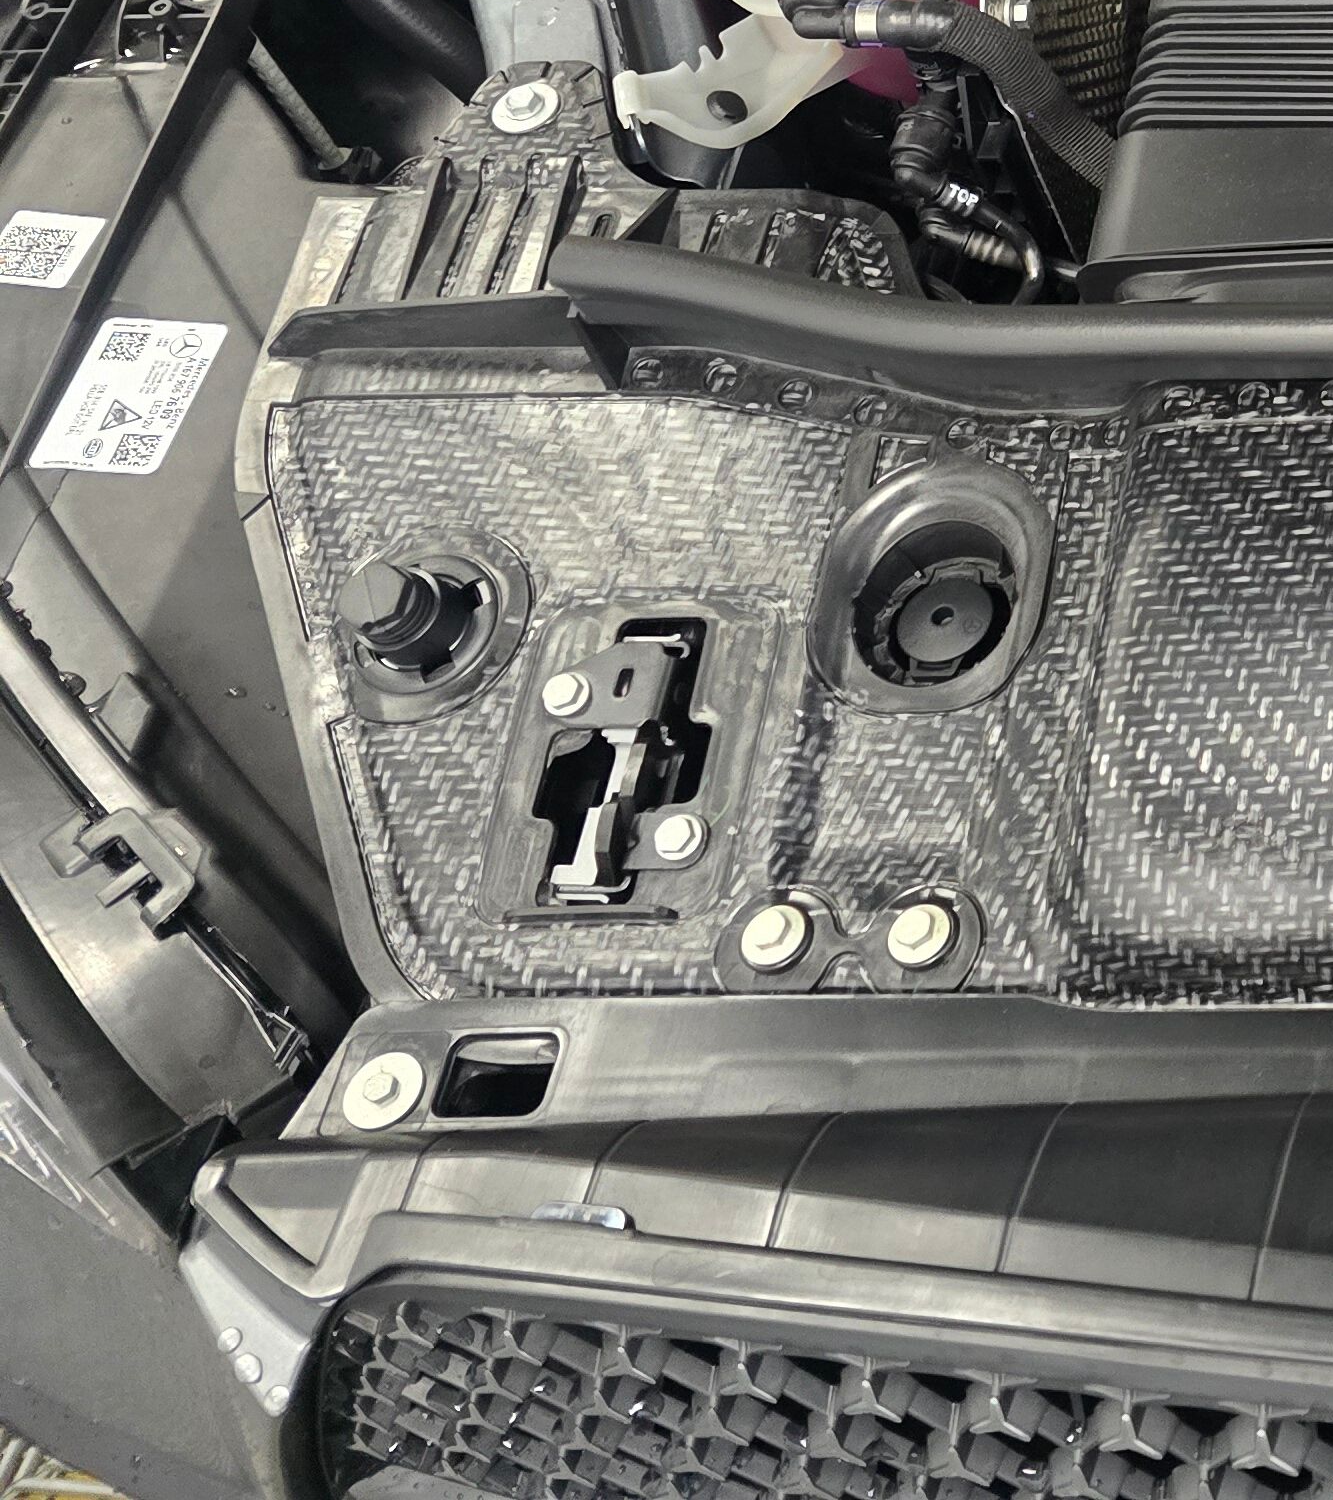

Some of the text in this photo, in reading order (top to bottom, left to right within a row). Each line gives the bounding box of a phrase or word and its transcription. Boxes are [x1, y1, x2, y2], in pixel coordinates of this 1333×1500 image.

[949, 183, 979, 207] TOP
[181, 365, 193, 376] 167
[182, 358, 210, 399] Mercedes
[172, 379, 187, 393] 906
[166, 396, 180, 406] 76
[166, 408, 184, 429] Benz
